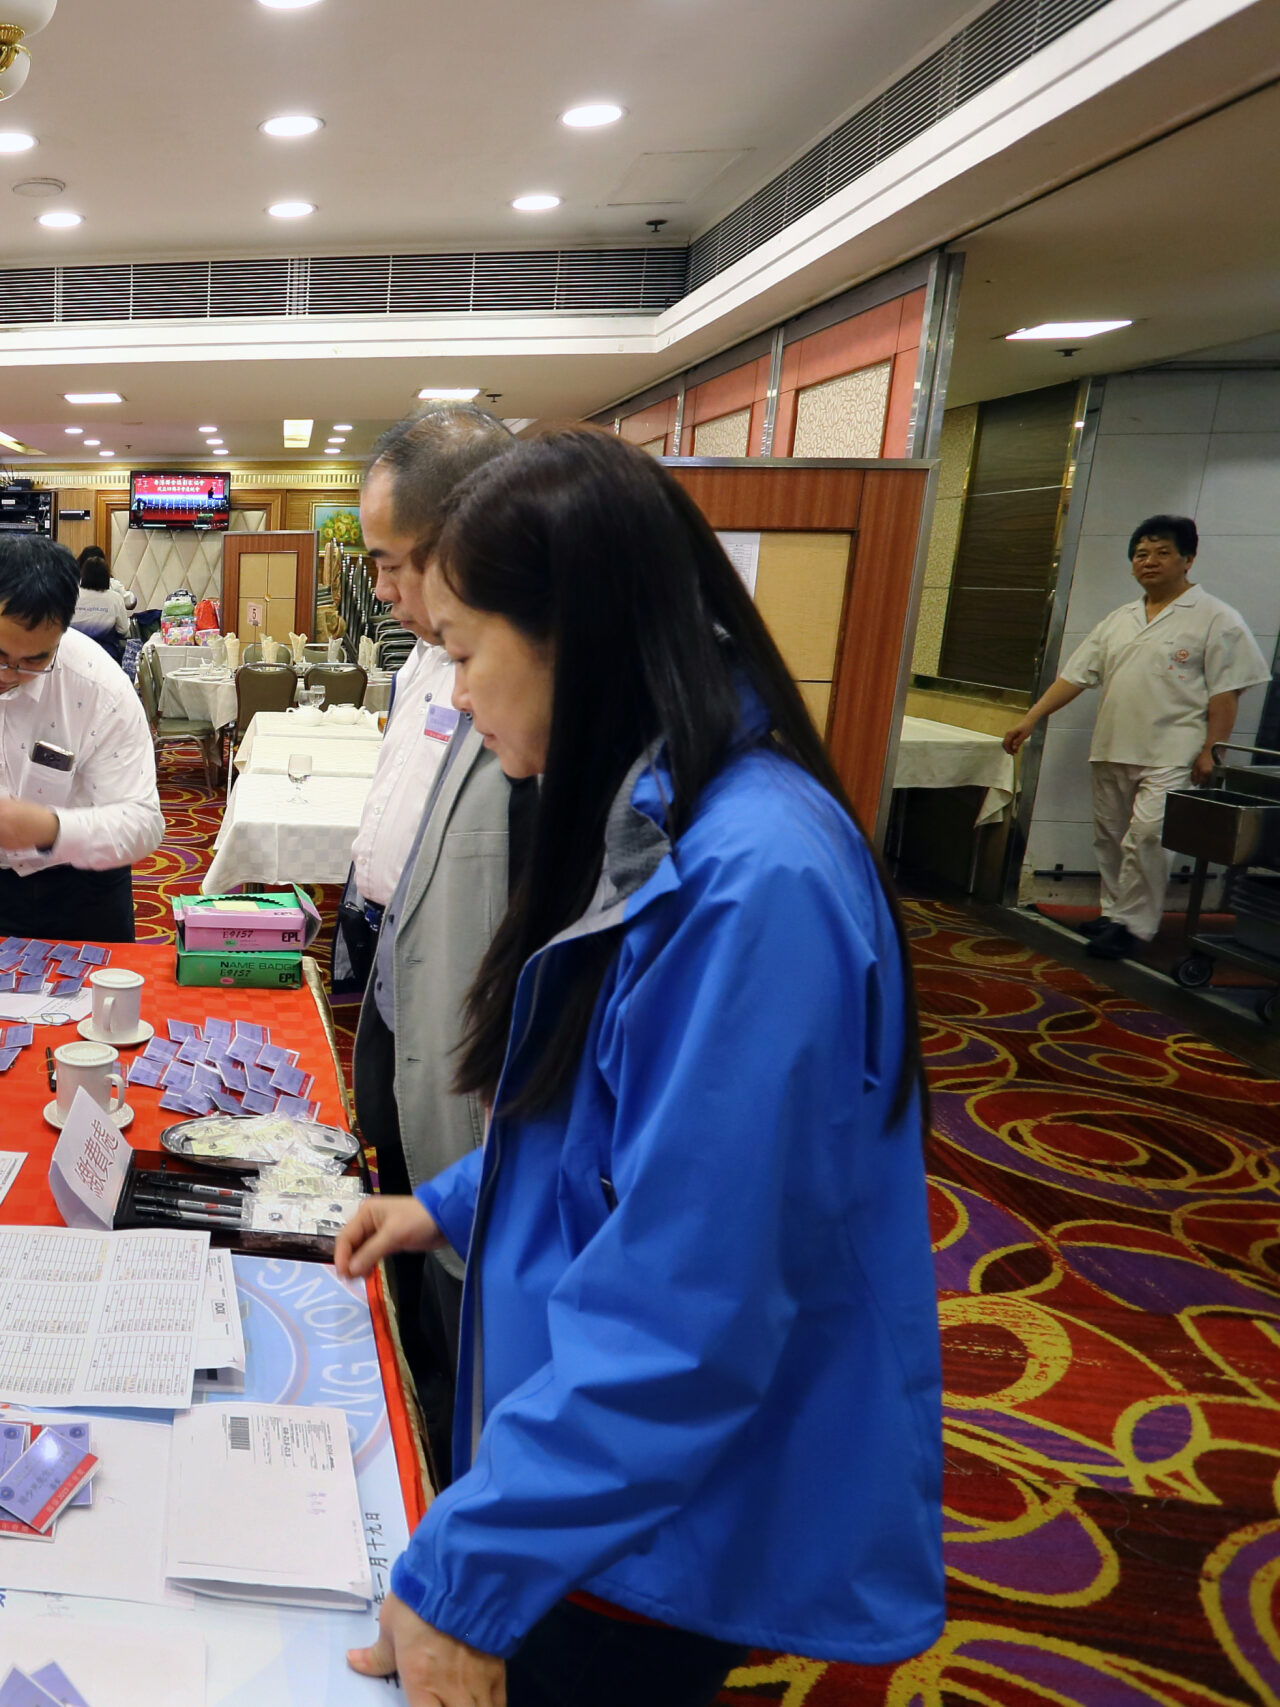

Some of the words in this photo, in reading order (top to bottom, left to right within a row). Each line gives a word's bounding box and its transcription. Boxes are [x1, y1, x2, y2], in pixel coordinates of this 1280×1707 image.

[252, 608, 257, 620] 5
[281, 931, 301, 943] EPL
[220, 961, 255, 970] NAME
[278, 973, 299, 984] EPL
